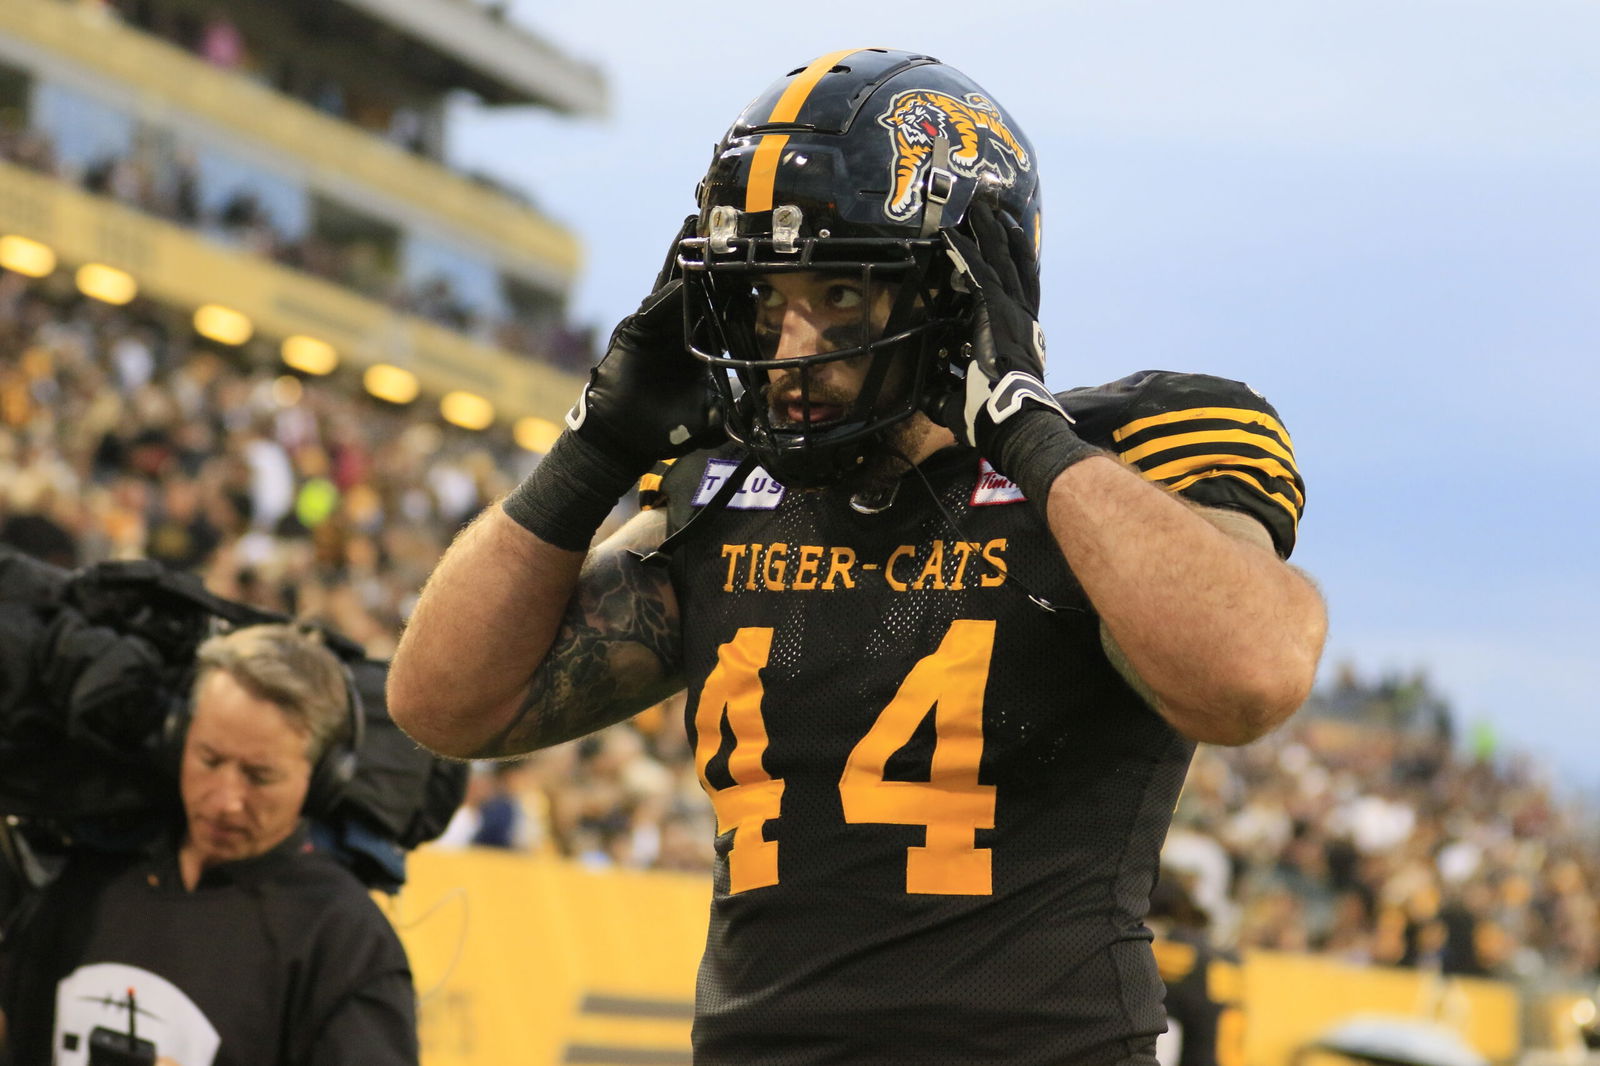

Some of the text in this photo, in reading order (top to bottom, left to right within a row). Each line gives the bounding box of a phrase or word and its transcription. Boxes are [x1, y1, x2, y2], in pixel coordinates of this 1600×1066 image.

[706, 475, 782, 494] TLUS
[721, 538, 1008, 592] TIGER-CATS
[695, 619, 997, 895] 44
